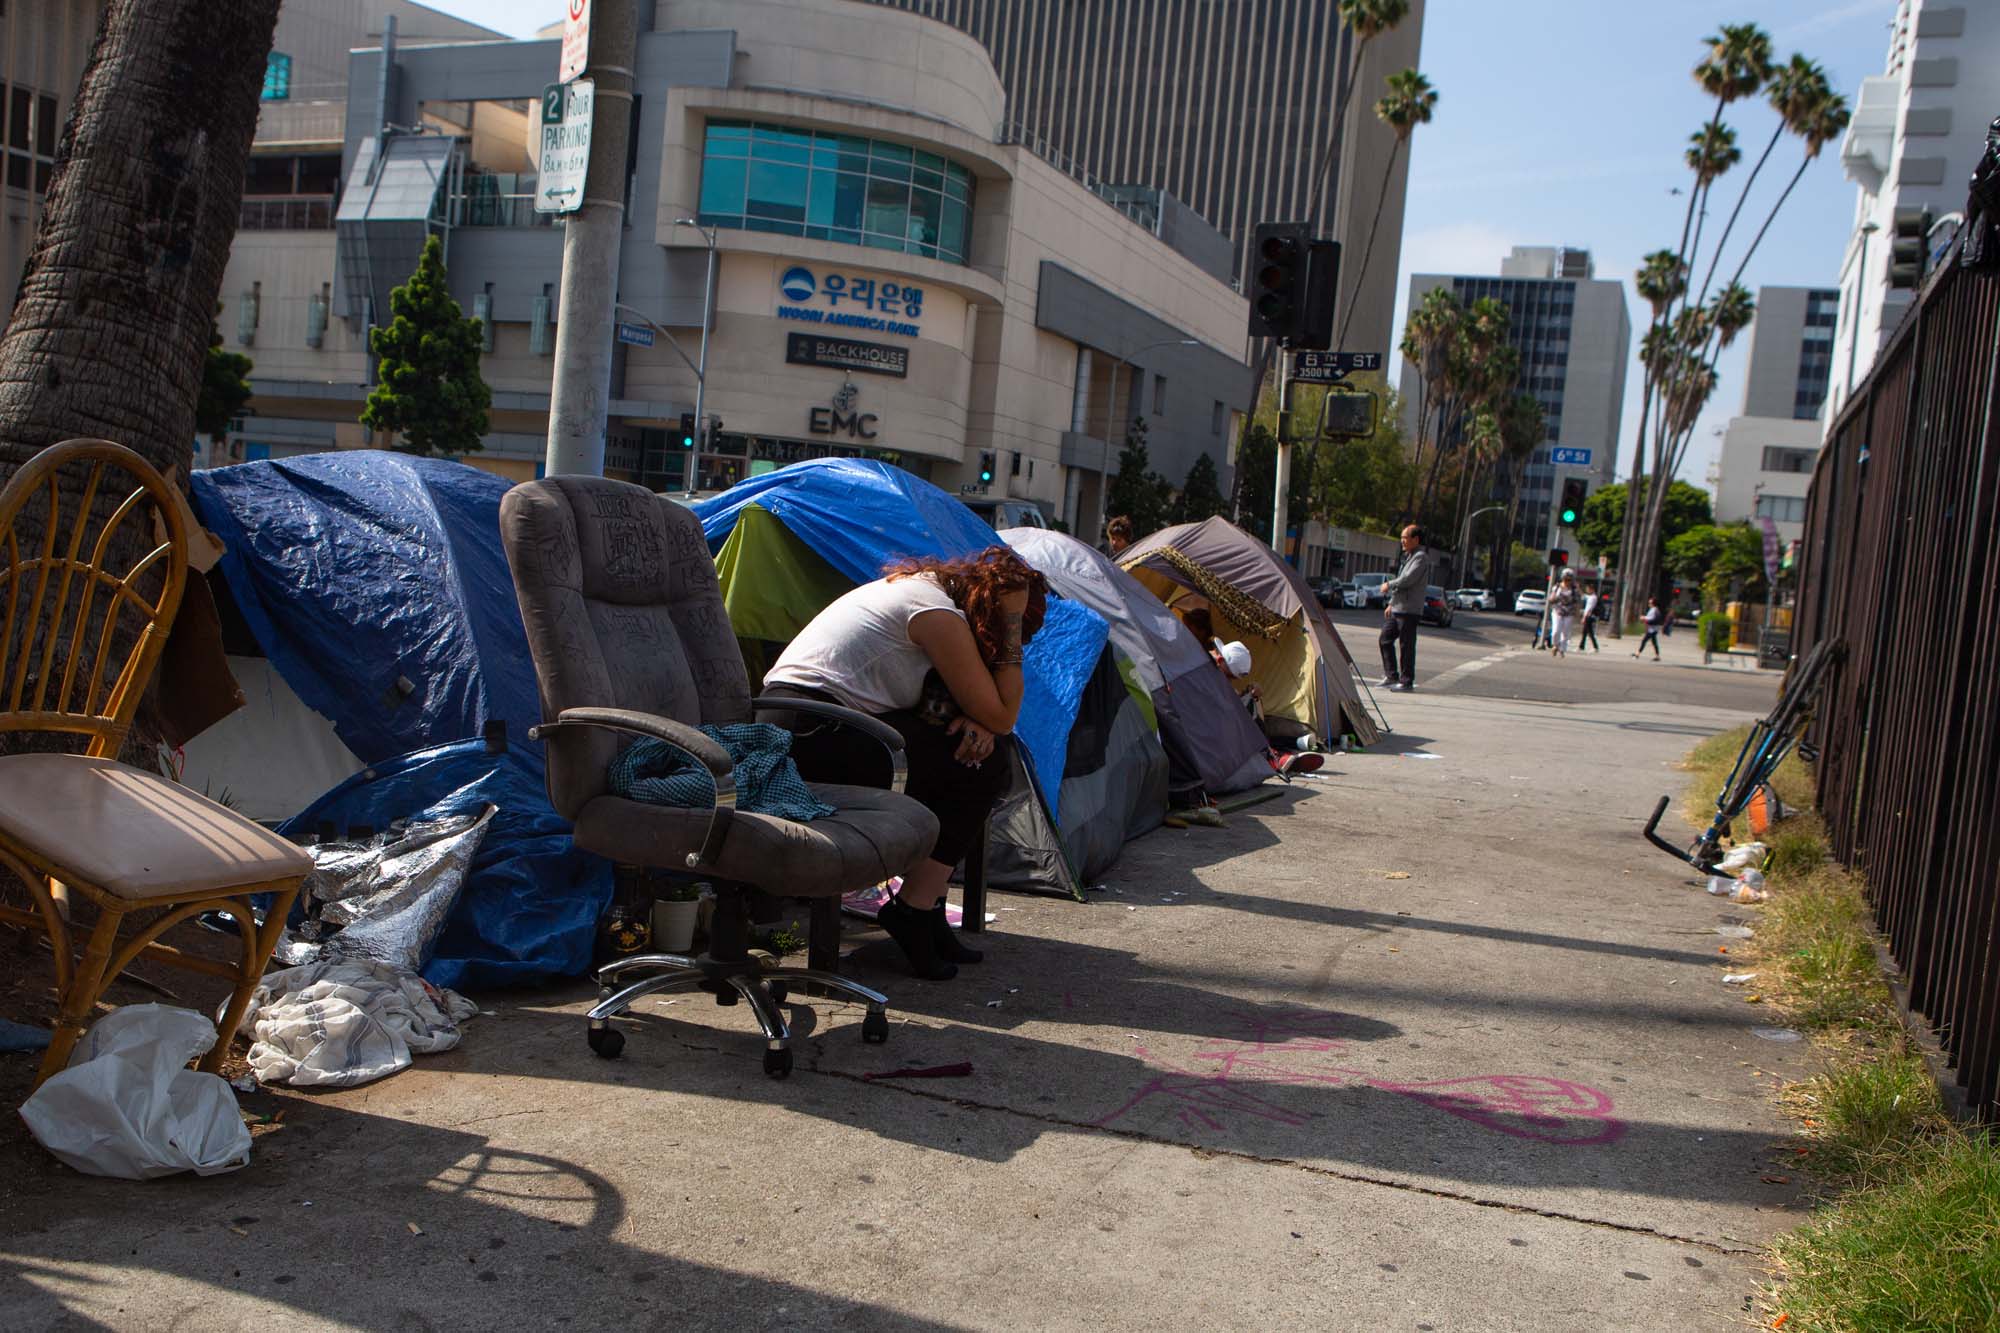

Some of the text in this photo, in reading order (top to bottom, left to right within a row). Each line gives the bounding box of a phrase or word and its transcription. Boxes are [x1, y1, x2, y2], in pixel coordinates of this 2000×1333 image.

[547, 91, 590, 120] 2 HOUR
[544, 123, 588, 151] PARKING
[821, 274, 923, 318] 우리은행
[778, 305, 920, 337] WOORI AMERICA BANK
[816, 341, 906, 365] BACKHOUSE
[1299, 367, 1322, 377] 3500
[809, 407, 879, 439] EMC
